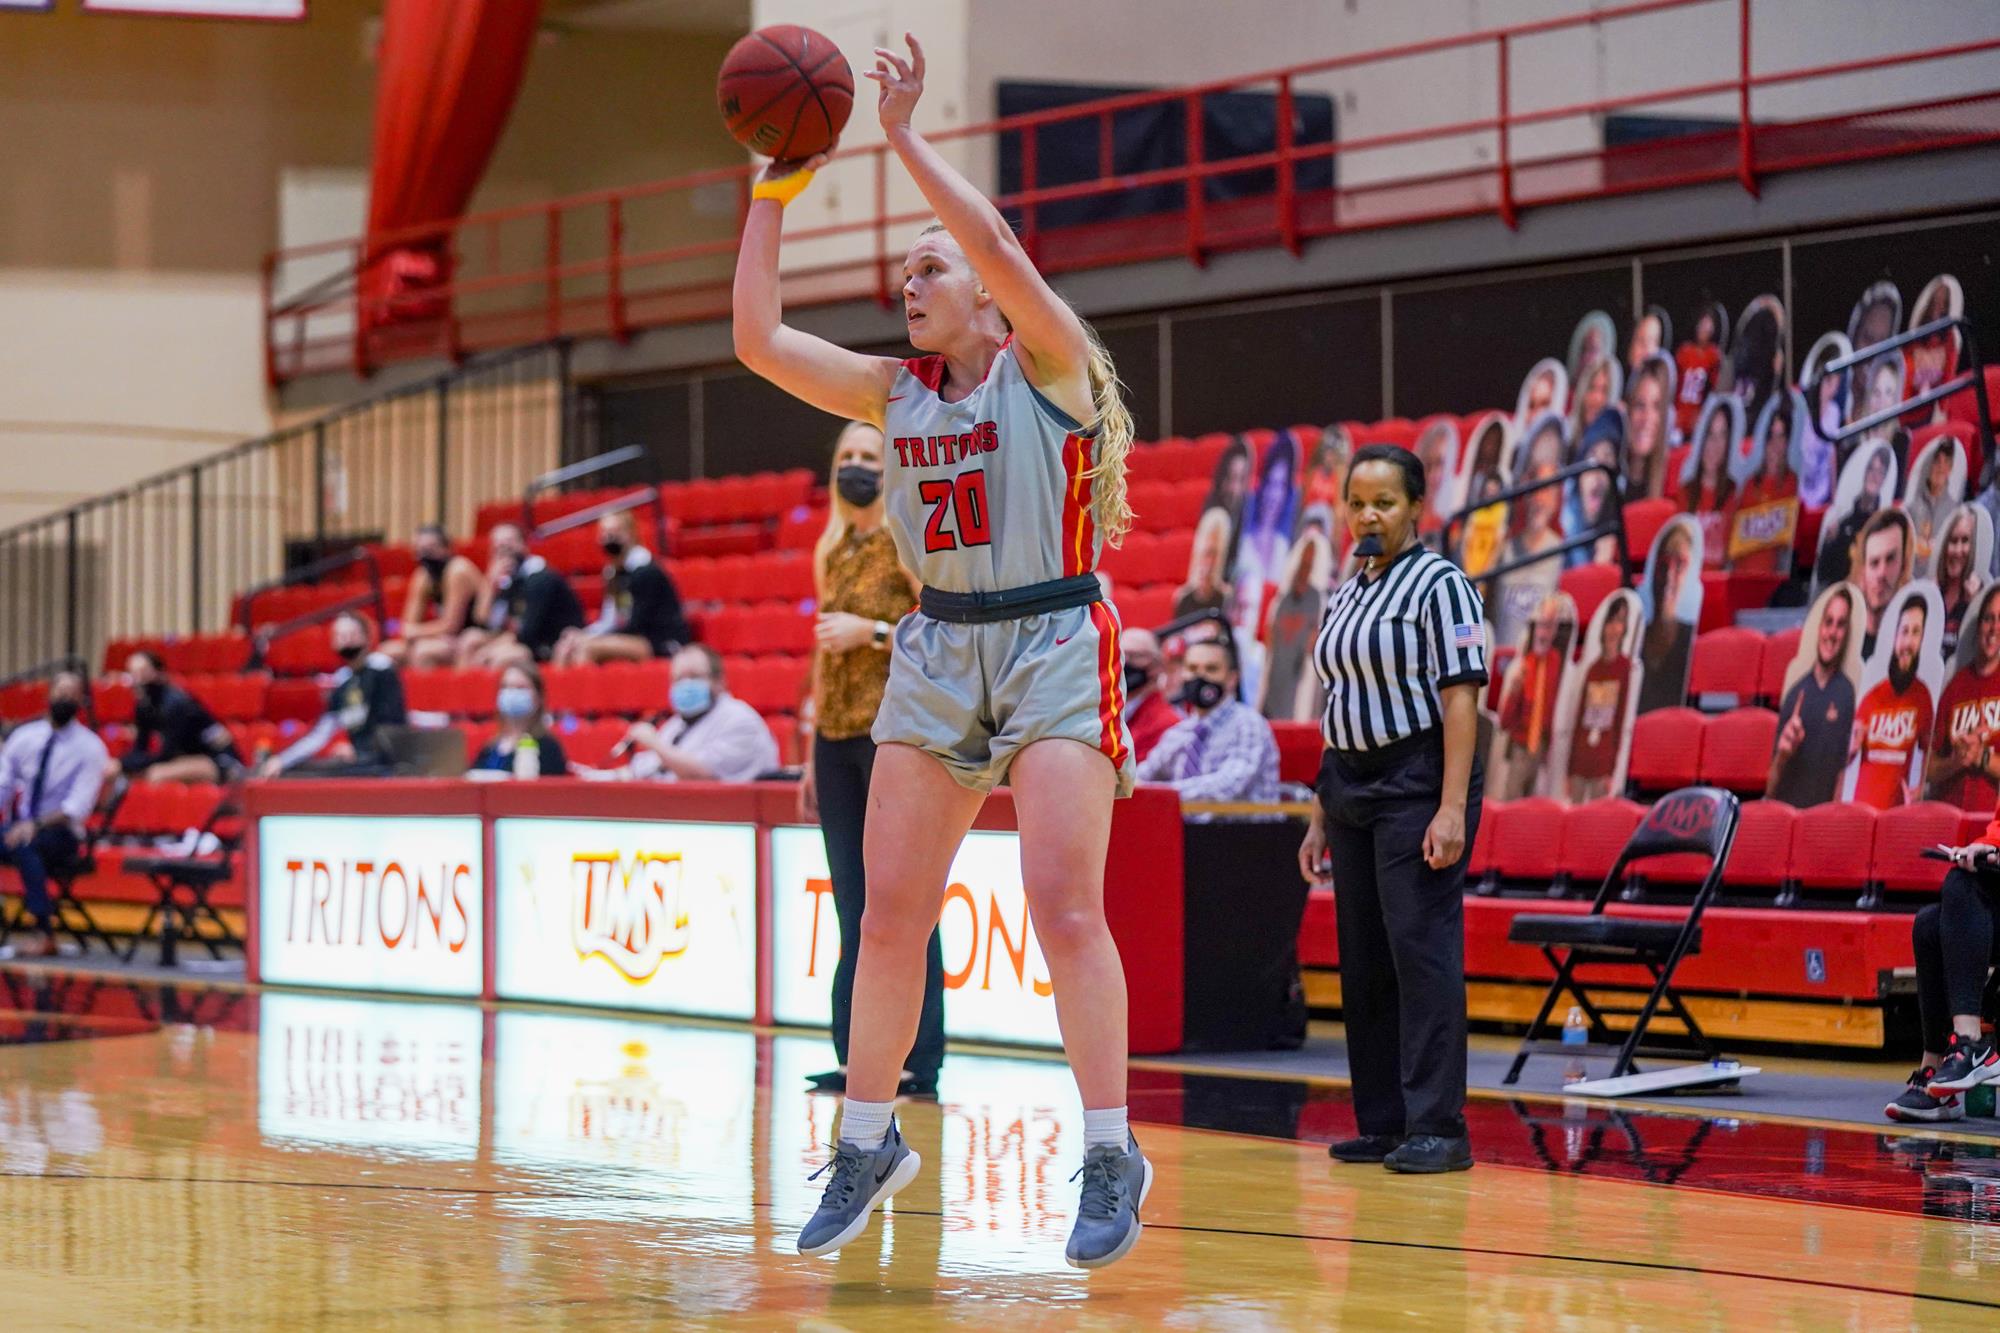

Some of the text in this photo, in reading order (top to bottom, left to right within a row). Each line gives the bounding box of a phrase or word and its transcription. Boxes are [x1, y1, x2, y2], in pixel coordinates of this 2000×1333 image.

[918, 468, 992, 554] 20
[1867, 709, 1916, 747] UMSL
[286, 860, 471, 953] TRITONS
[572, 850, 689, 984] UMSL
